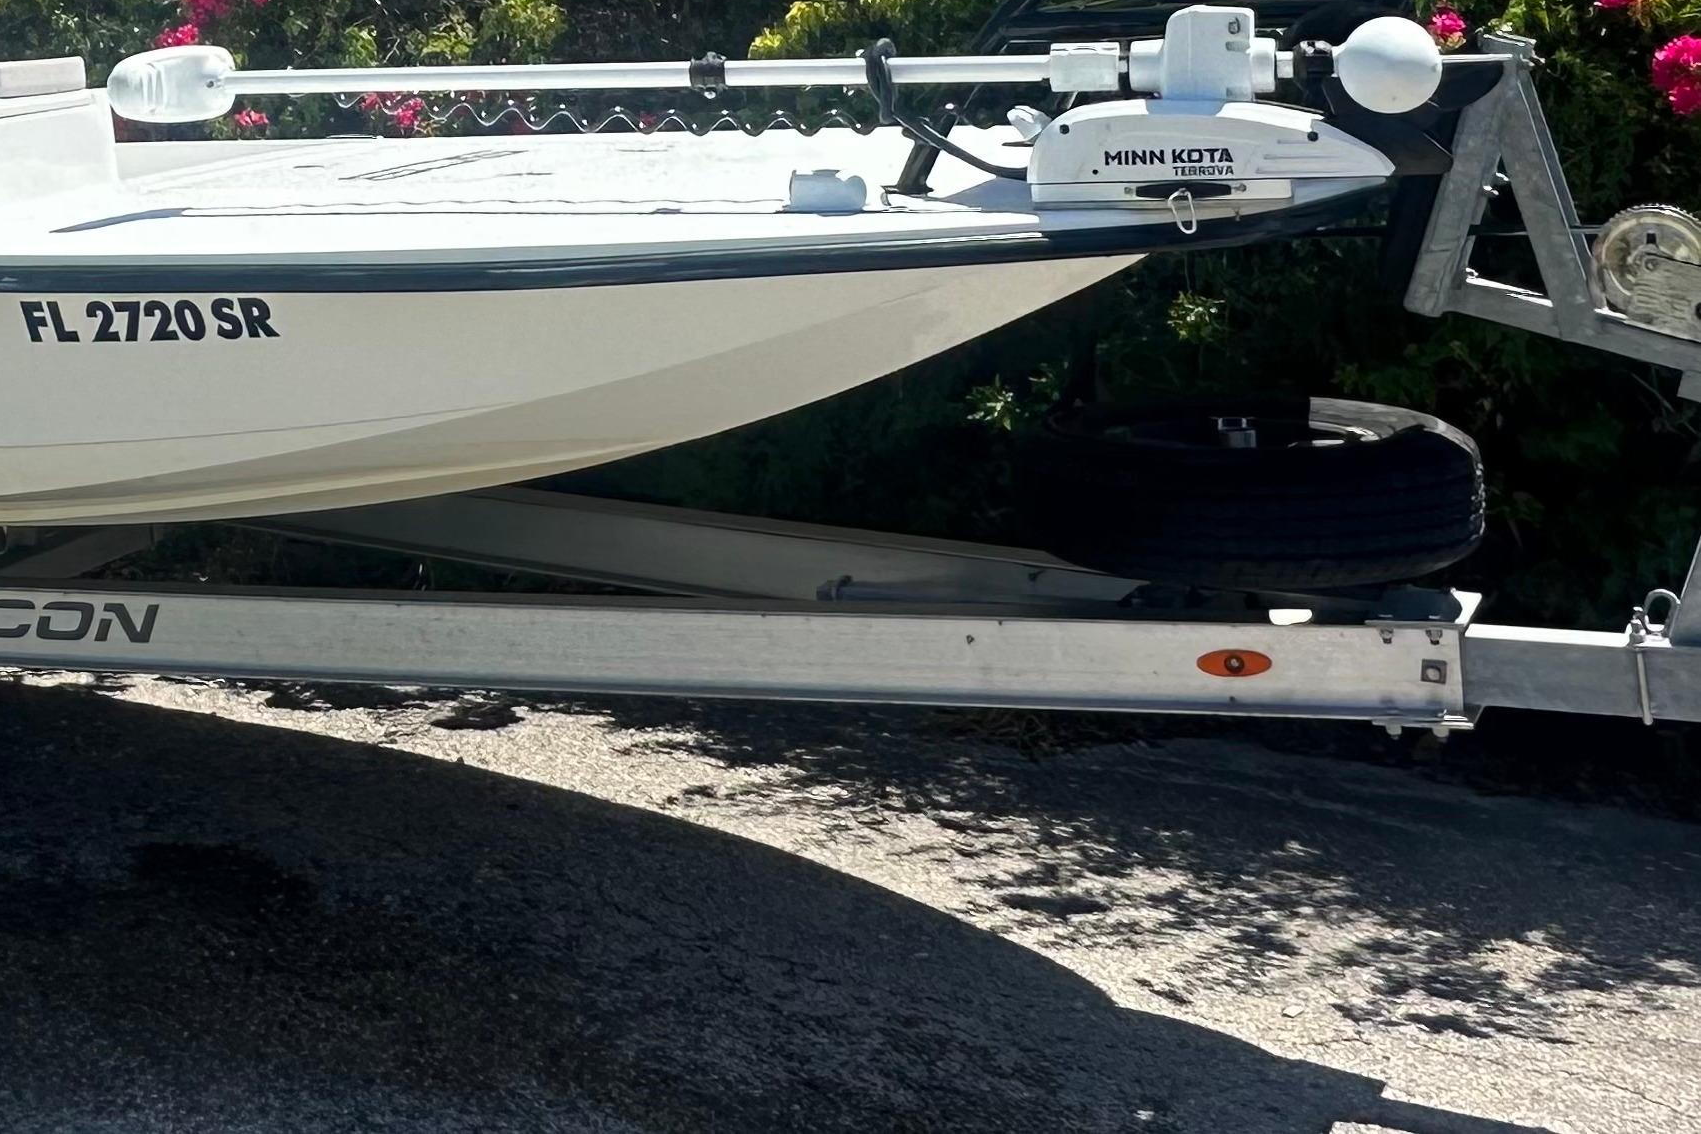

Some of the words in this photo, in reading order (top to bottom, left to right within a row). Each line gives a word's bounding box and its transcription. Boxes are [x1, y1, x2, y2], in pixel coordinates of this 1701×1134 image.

[1104, 149, 1165, 166] MINN
[1172, 148, 1234, 164] KOTA
[20, 301, 80, 343] FL
[86, 299, 206, 342] 2720
[211, 297, 280, 340] SR
